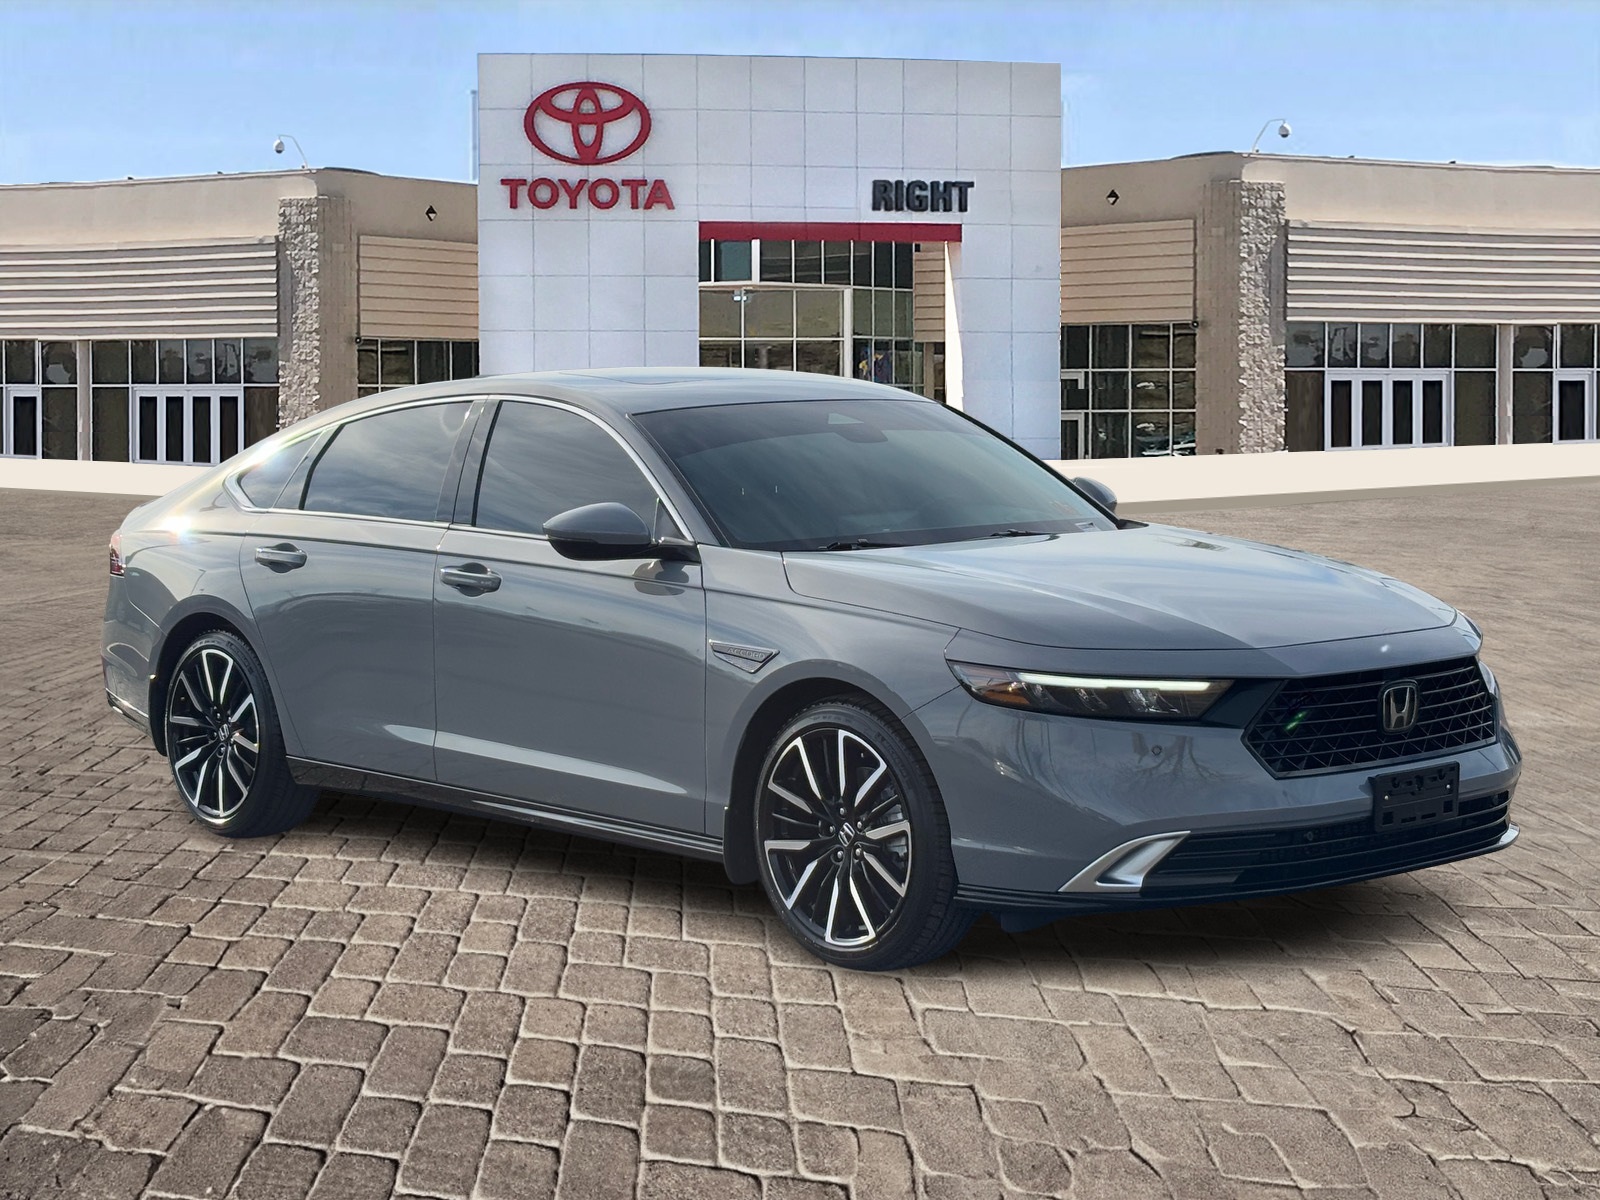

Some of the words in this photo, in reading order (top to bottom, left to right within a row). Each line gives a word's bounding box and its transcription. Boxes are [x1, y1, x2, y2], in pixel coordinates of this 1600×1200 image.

[500, 177, 675, 210] TOYOTA
[872, 179, 975, 213] RIGHT
[727, 646, 765, 660] ACCORD
